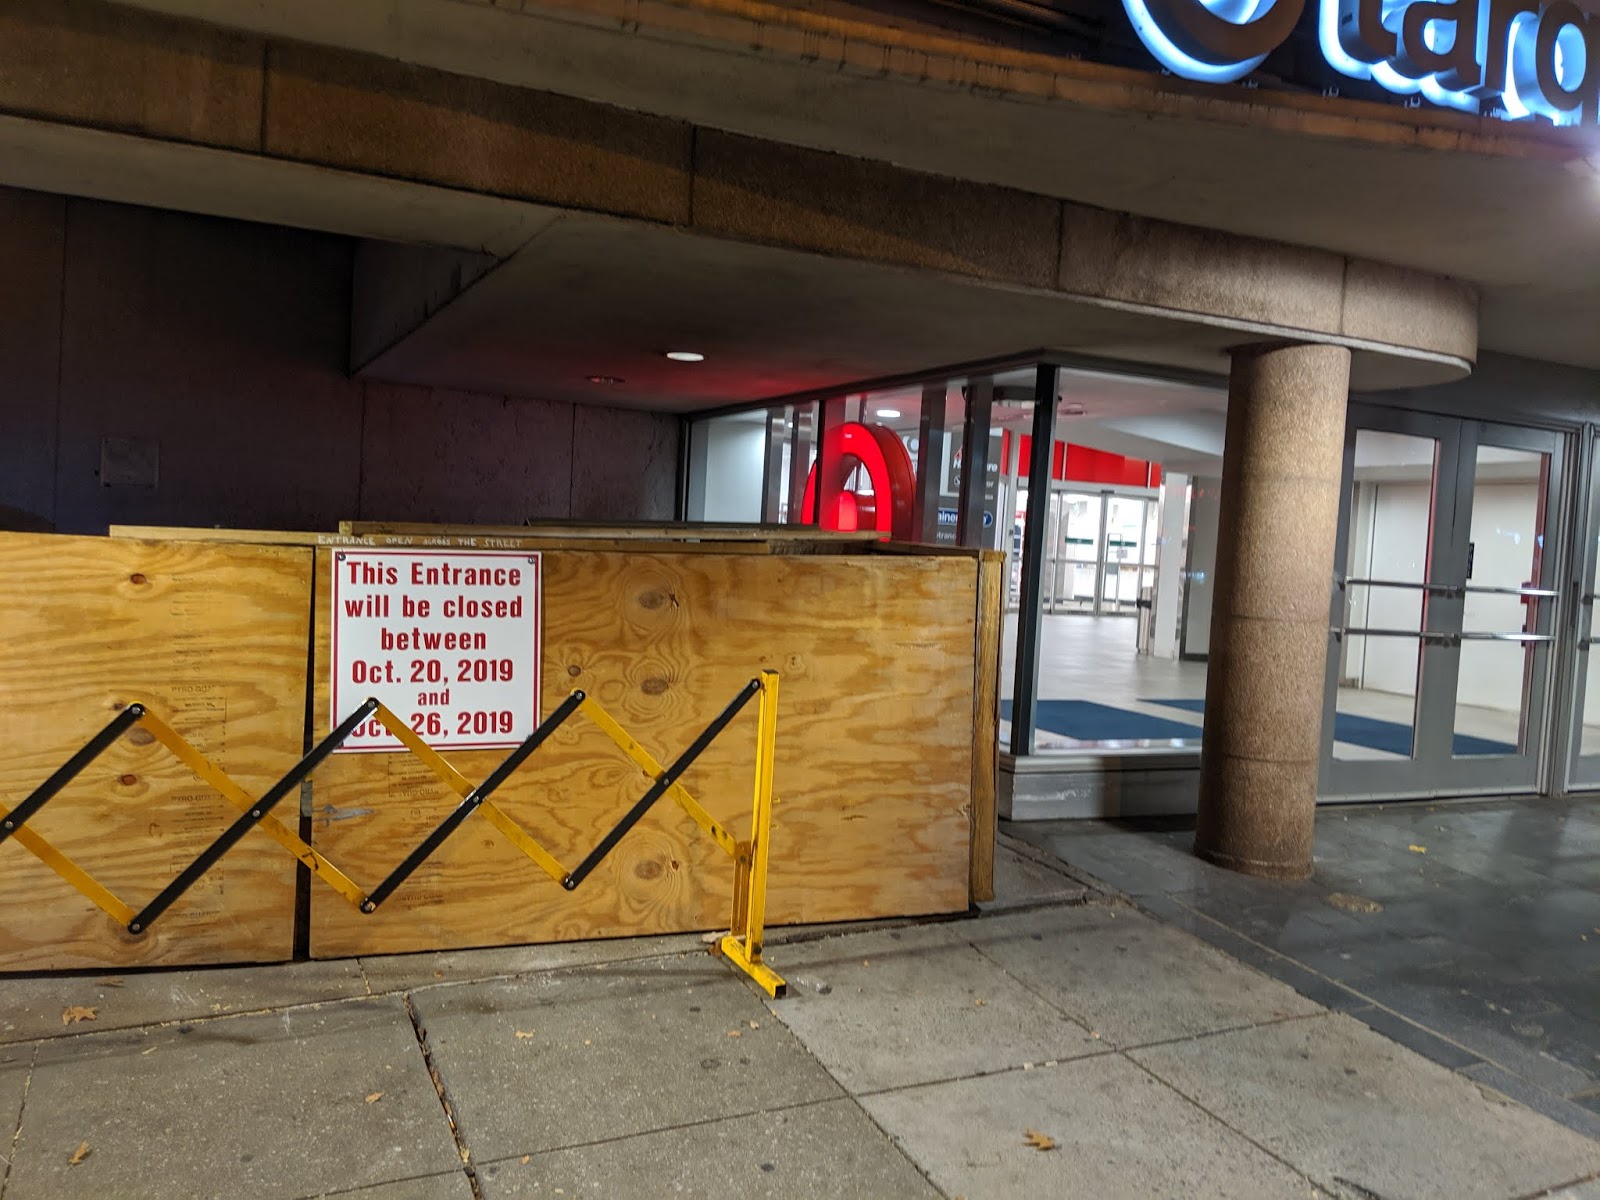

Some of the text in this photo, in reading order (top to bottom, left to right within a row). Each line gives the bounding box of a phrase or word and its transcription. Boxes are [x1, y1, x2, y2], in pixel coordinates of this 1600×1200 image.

[317, 535, 522, 548] ENTRANCE OPEN ACROSS THE STREET
[346, 561, 521, 586] This Entrance
[344, 594, 523, 618] will be closed
[380, 627, 487, 651] between
[352, 659, 514, 686] Oct. 20, 2019
[417, 688, 450, 706] and
[410, 711, 449, 738] 26,
[457, 710, 514, 735] 2019
